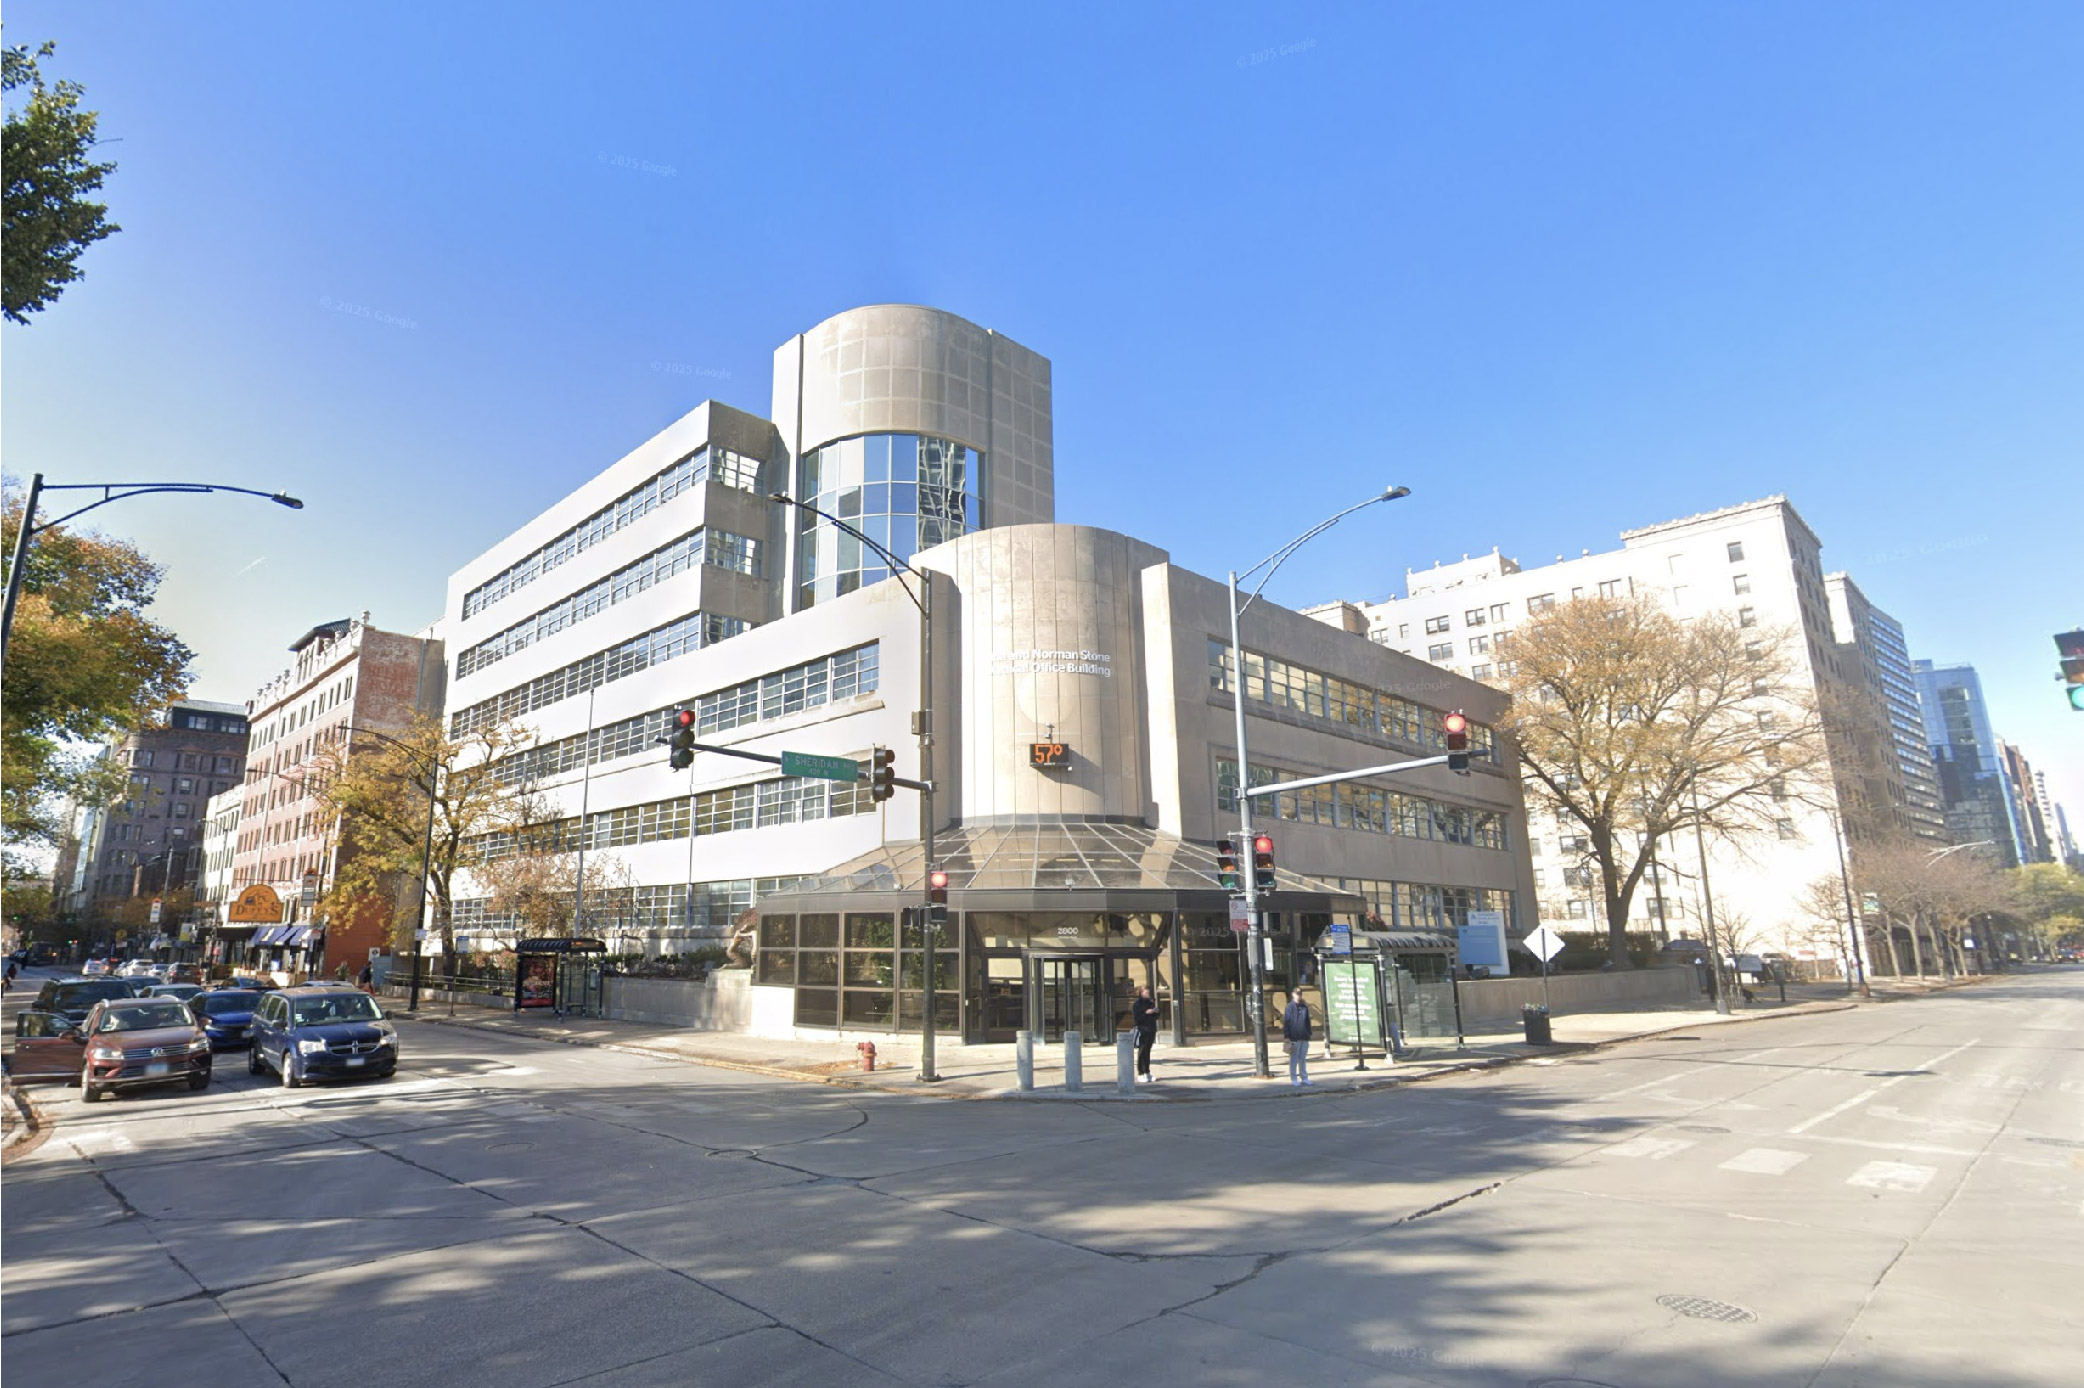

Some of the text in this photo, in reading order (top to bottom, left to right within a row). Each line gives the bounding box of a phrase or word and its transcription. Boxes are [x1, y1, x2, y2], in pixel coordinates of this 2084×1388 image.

[1032, 649, 1078, 660] Norman
[1080, 650, 1110, 662] Stone
[1033, 662, 1065, 673] Office
[1067, 663, 1111, 677] Building
[795, 756, 839, 769] SHERIDAN
[1057, 927, 1078, 935] 2800
